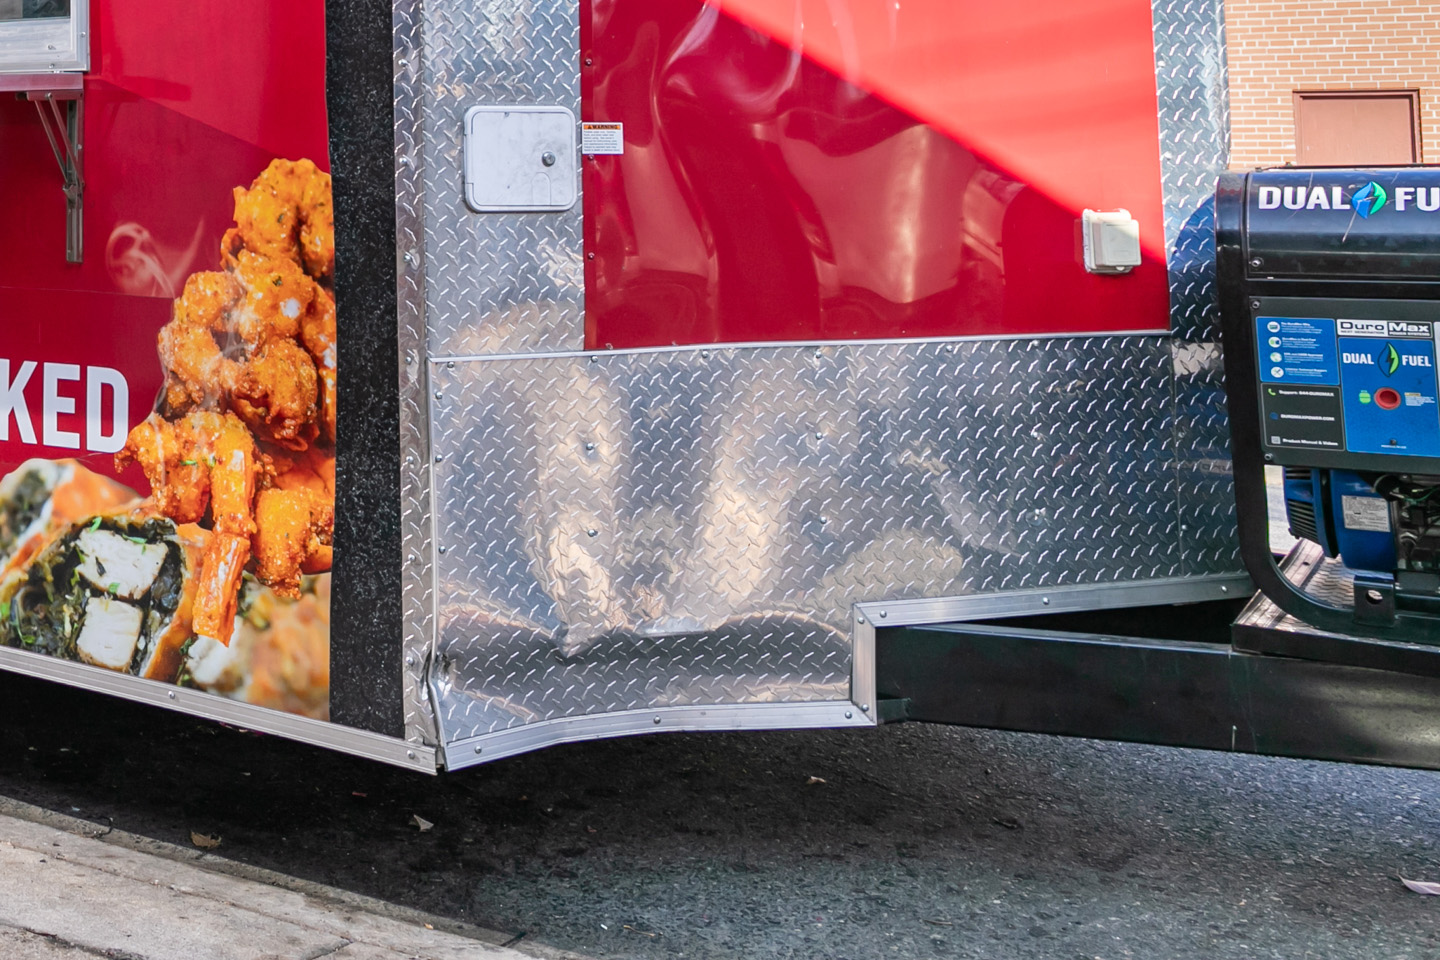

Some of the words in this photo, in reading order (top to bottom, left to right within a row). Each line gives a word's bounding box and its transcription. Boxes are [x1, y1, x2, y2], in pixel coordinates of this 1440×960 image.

[1258, 186, 1351, 210] DUAL
[1342, 352, 1375, 365] DUAL
[1401, 355, 1432, 367] FUEL
